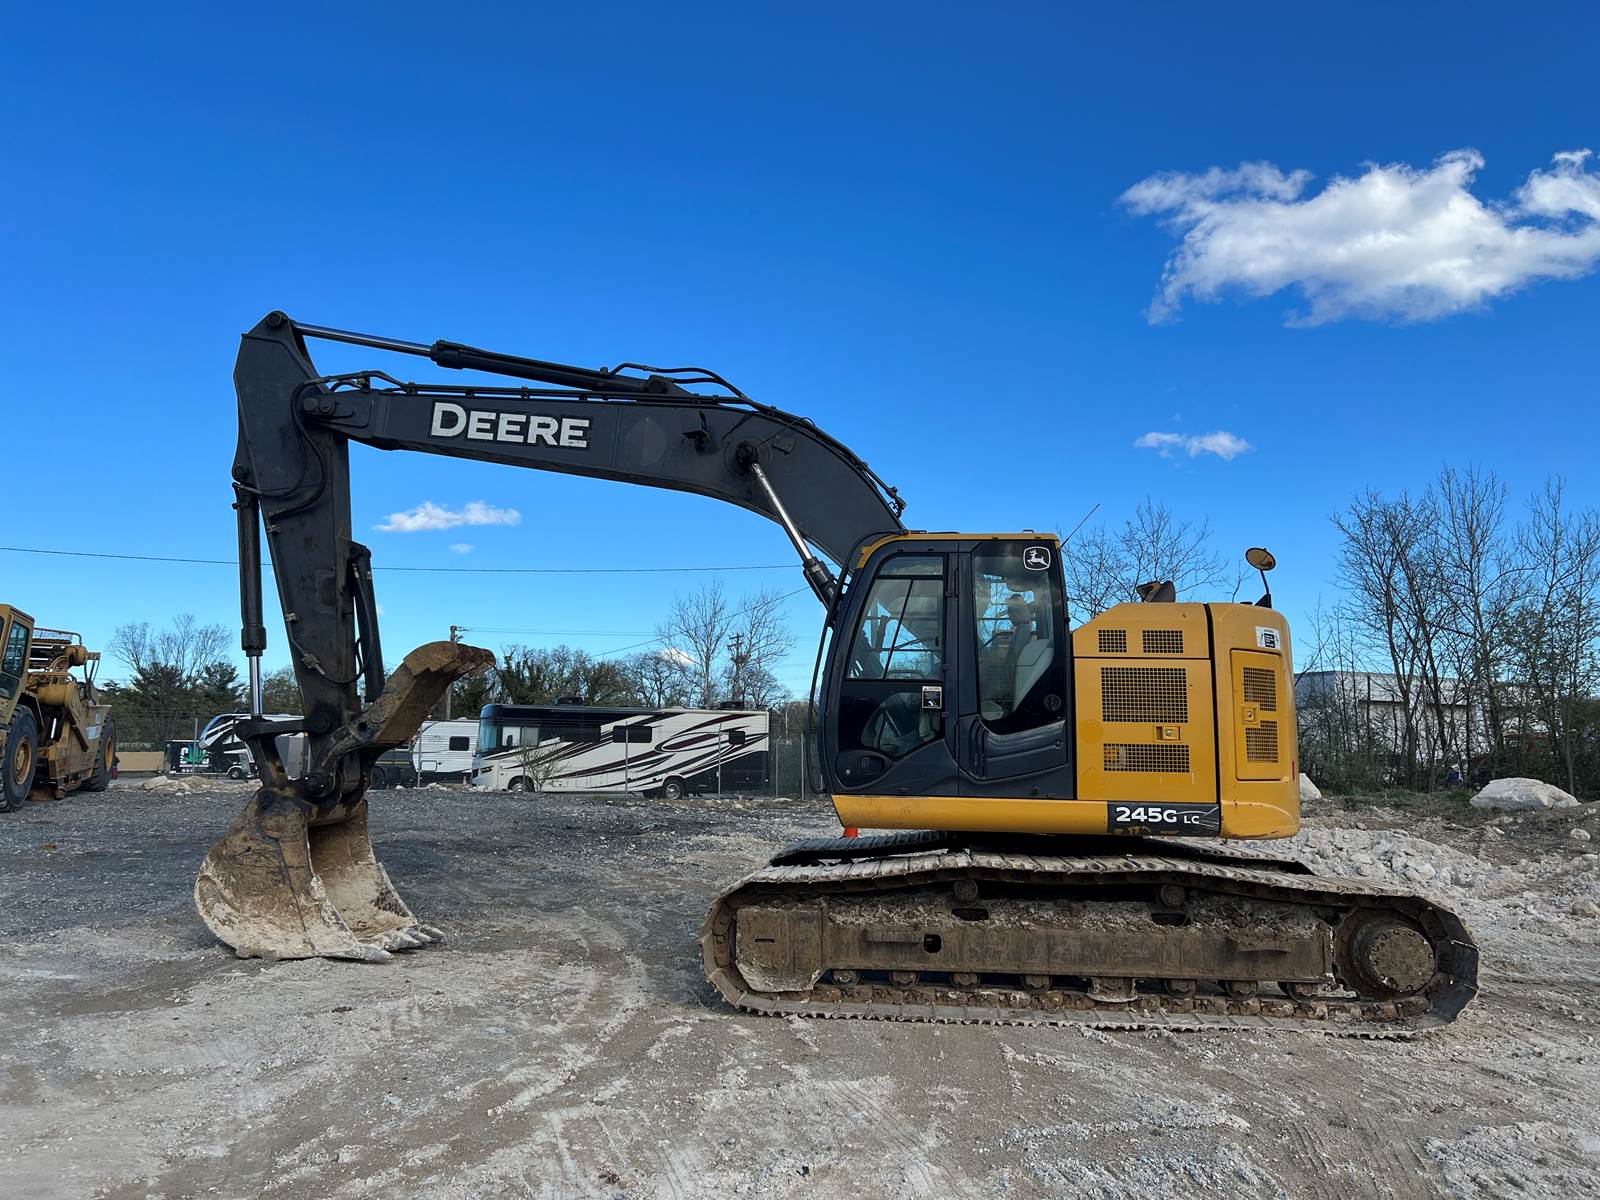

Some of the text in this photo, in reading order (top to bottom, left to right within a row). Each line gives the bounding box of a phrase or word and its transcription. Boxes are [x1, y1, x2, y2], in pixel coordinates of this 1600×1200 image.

[431, 402, 590, 448] DEERE
[1116, 806, 1200, 824] 245G LC
